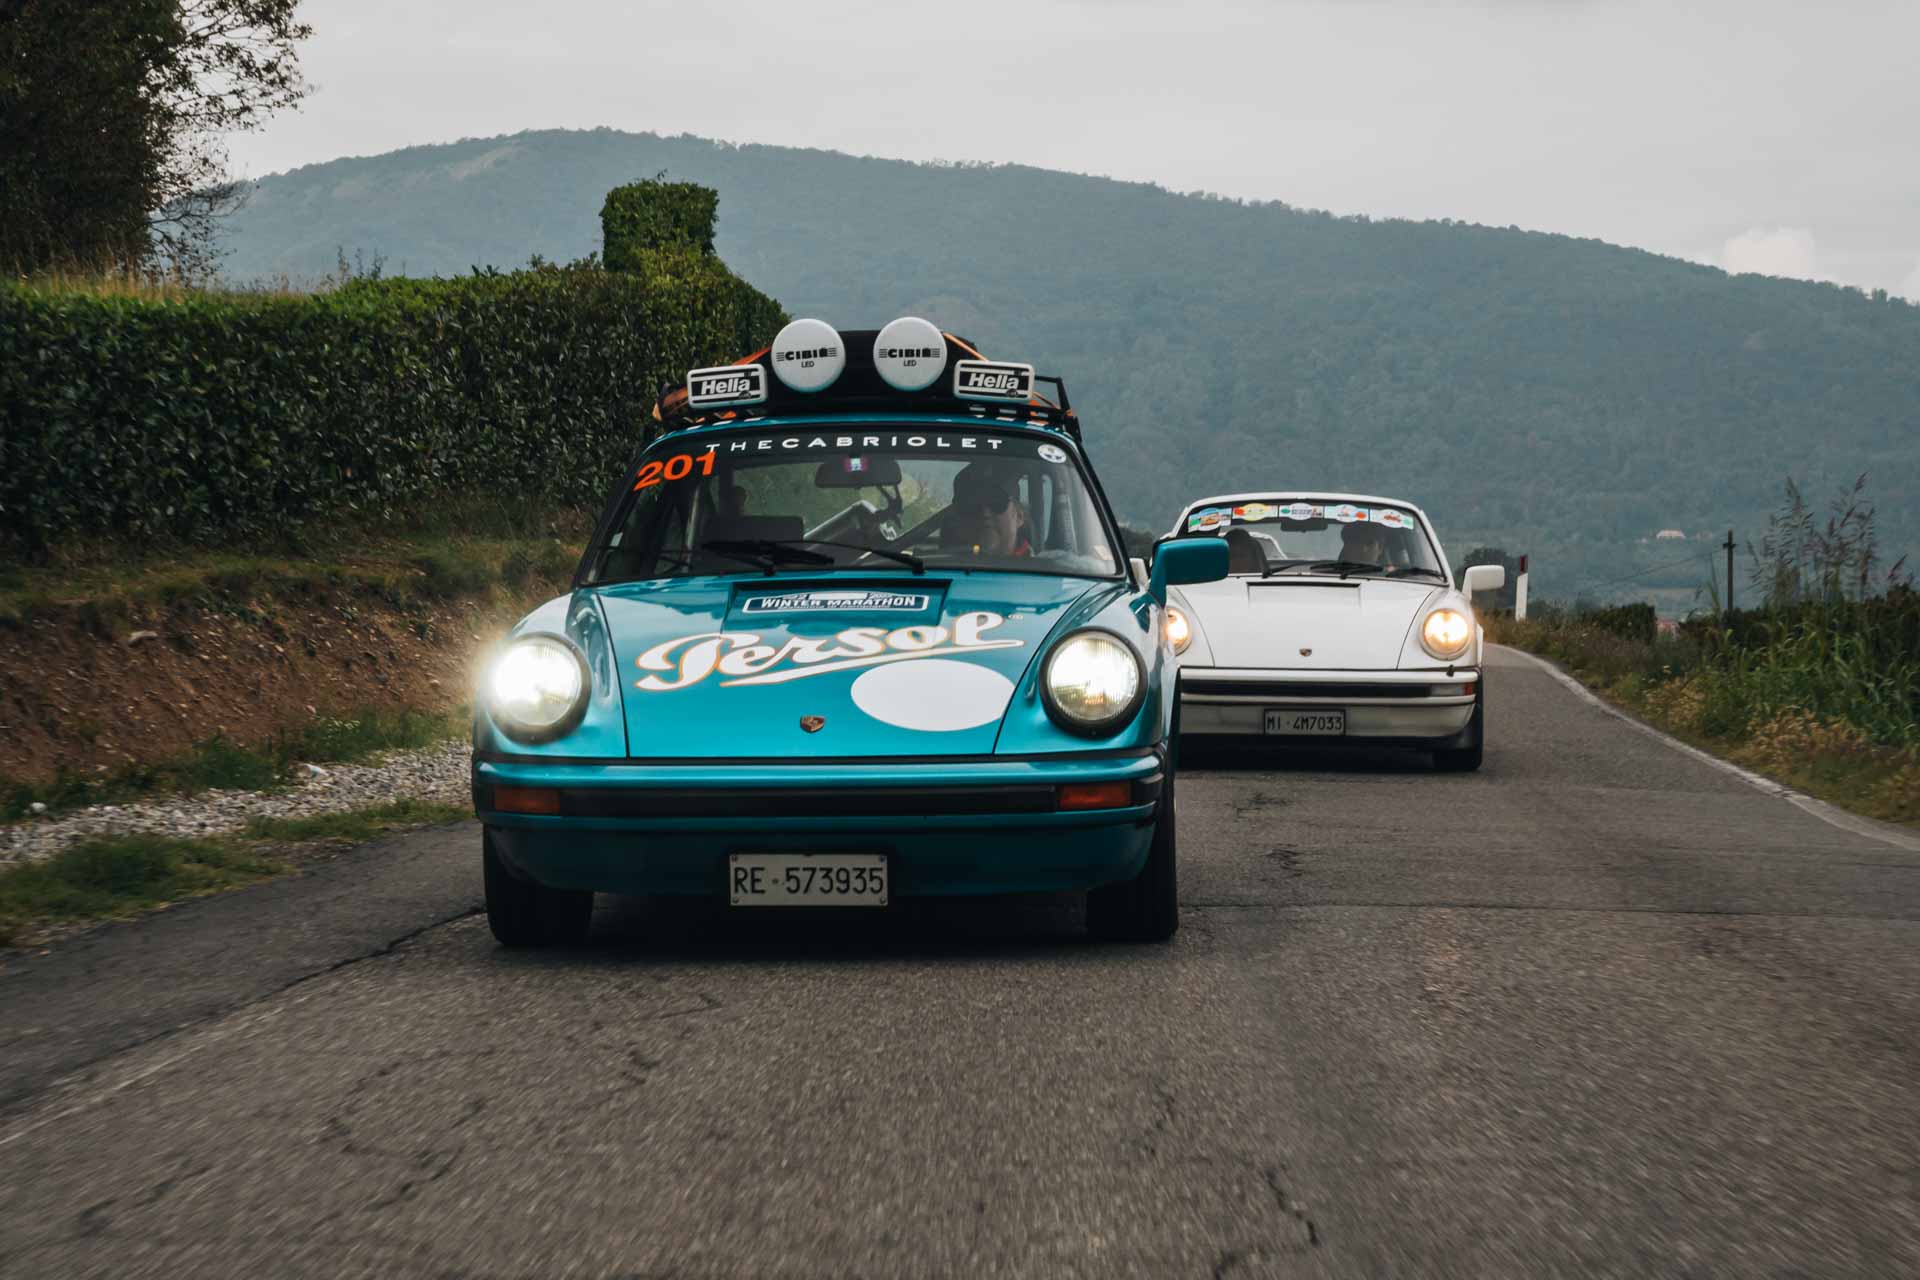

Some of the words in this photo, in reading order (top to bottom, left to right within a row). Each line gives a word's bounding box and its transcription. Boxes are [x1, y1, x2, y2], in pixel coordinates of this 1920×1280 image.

[701, 378, 750, 395] Hella
[968, 373, 1019, 389] Hella
[633, 450, 716, 491] 201
[761, 598, 821, 608] WINTER
[827, 596, 916, 607] MARATHON
[635, 611, 1006, 690] Persol
[1293, 716, 1342, 730] 4M7033
[734, 867, 766, 894] RE
[785, 867, 884, 894] 573935
